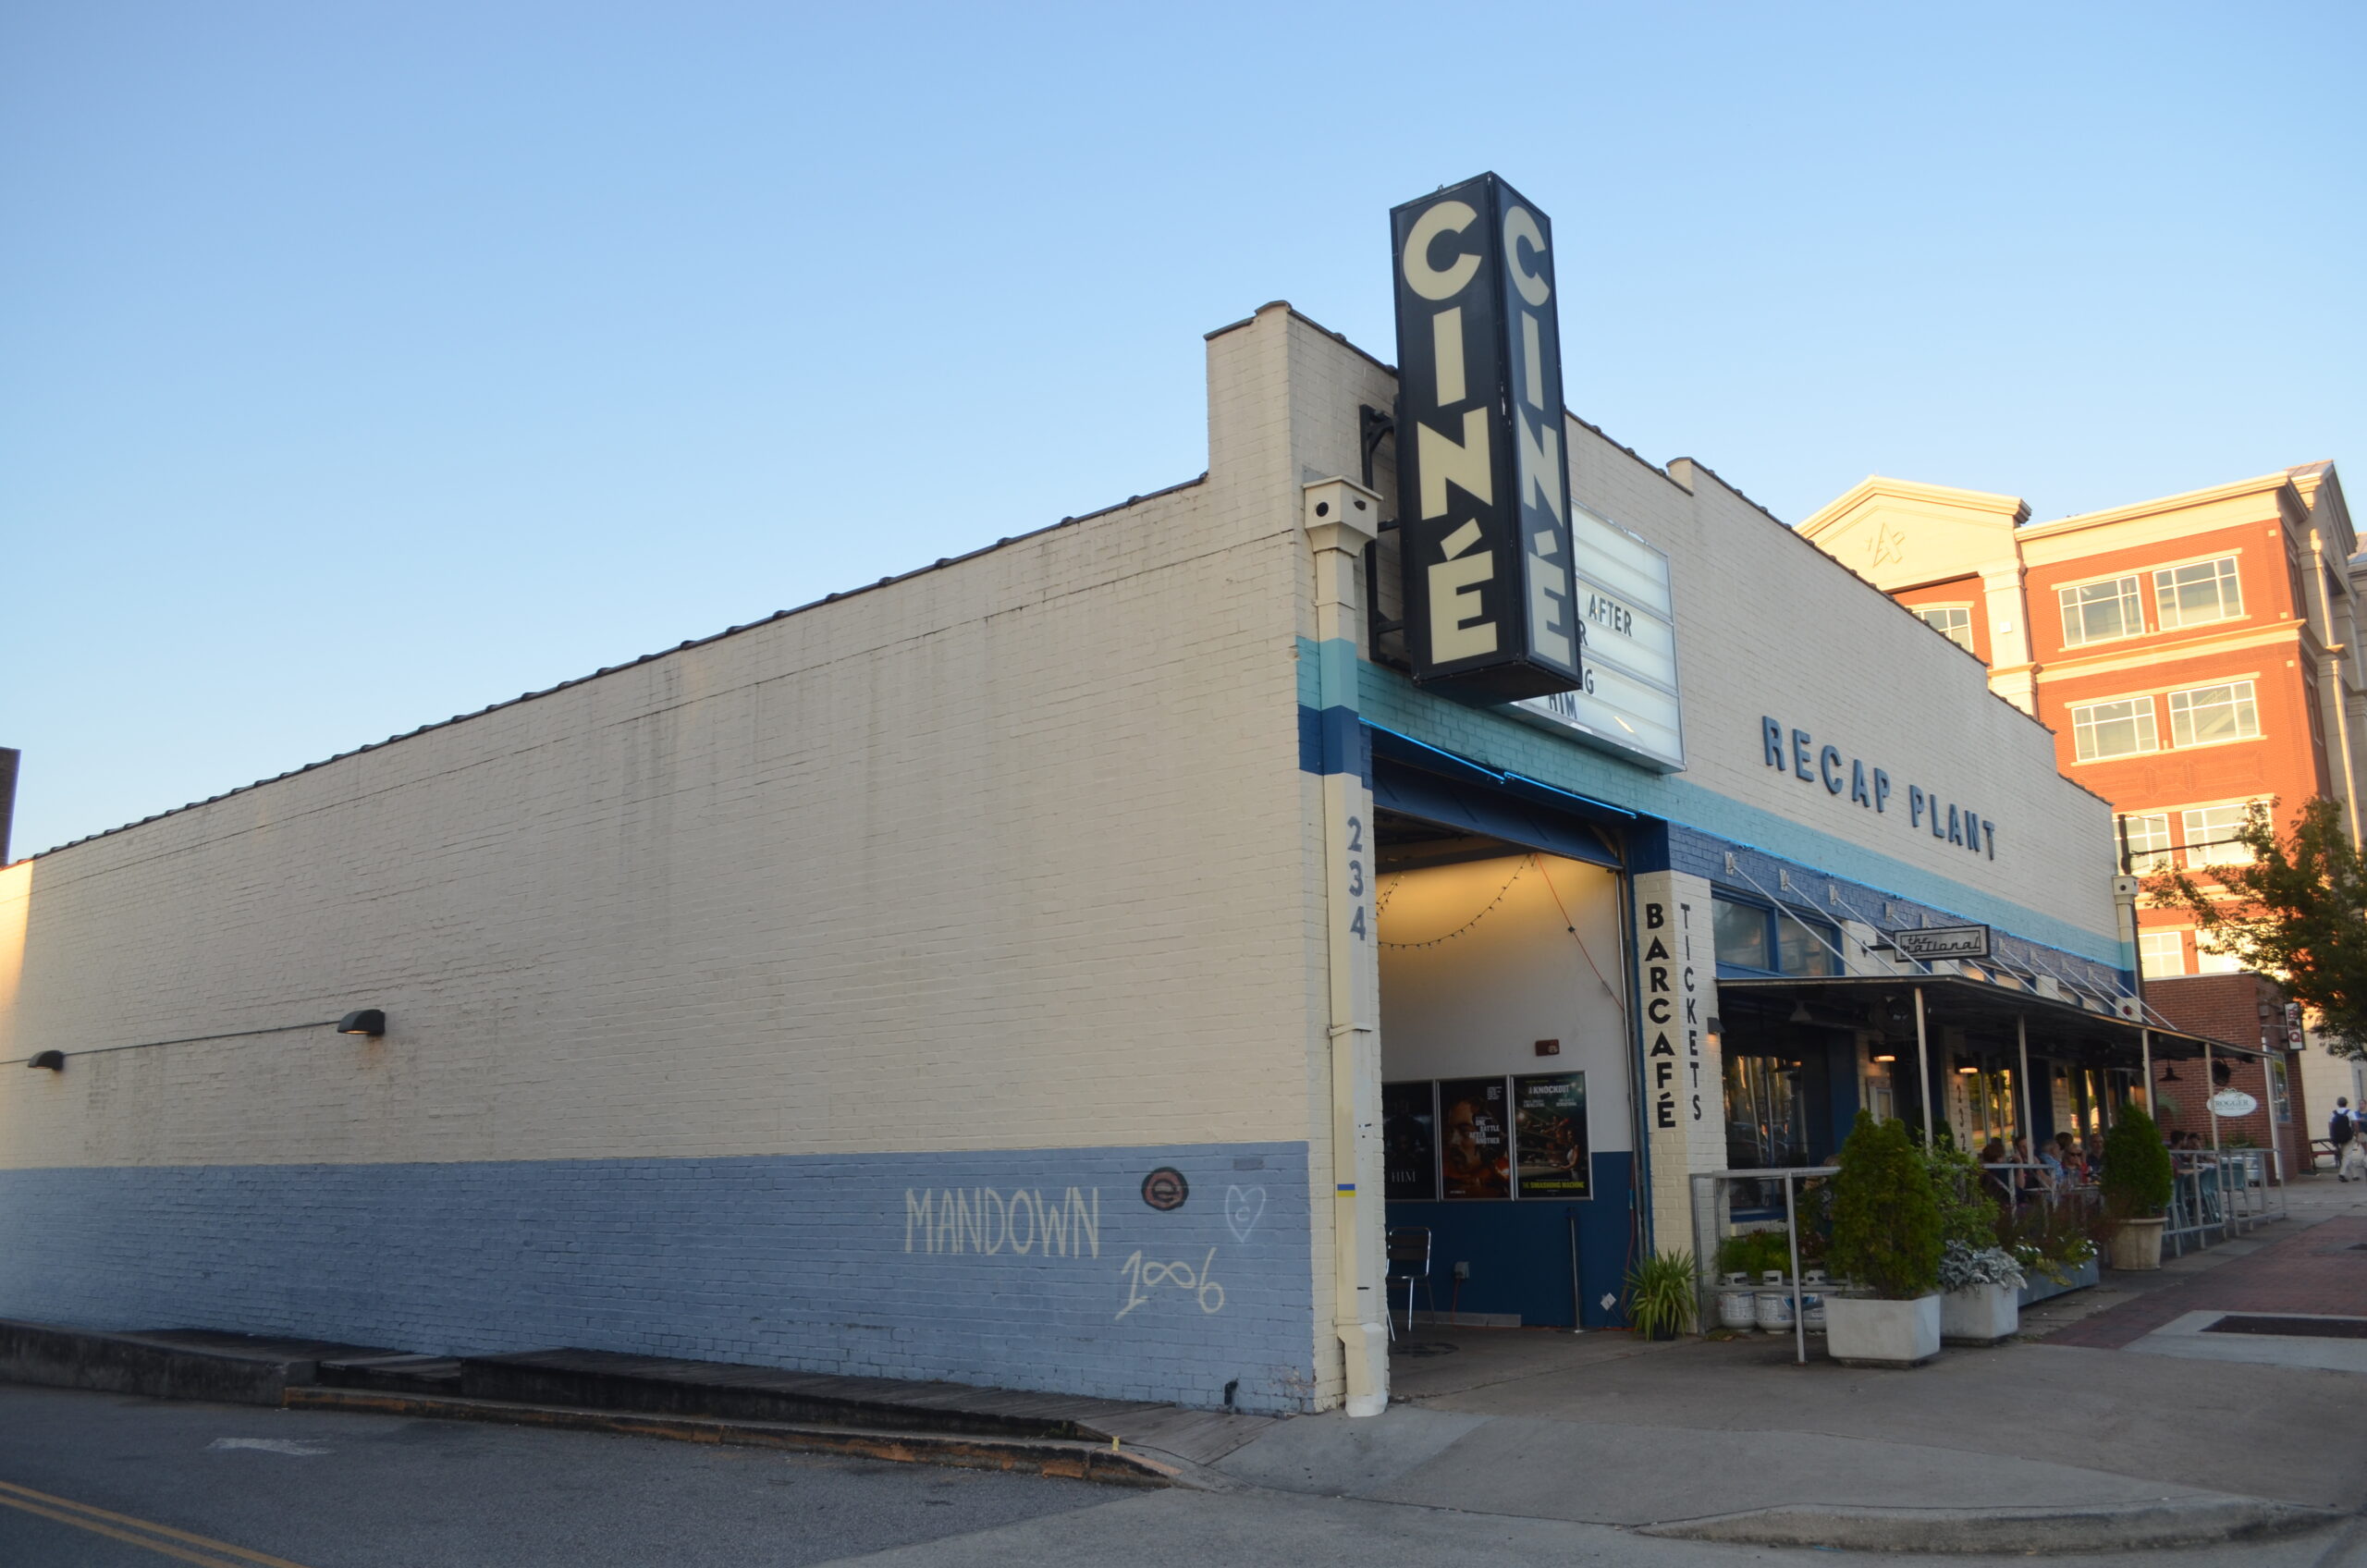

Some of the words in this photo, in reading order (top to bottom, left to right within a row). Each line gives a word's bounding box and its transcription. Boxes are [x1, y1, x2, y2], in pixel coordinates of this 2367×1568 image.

[1403, 200, 1499, 665] CINÉ
[1502, 205, 1572, 668] CINÉ
[1588, 594, 1632, 637] AFTER
[1549, 692, 1577, 720] HIM
[1762, 716, 1891, 814] RECAP
[1908, 784, 1995, 861] PLANT
[1346, 815, 1367, 941] 234
[1901, 937, 1981, 953] national
[1680, 902, 1702, 1121] TICKETS
[904, 1187, 1098, 1259] MANDOWN
[1392, 1170, 1417, 1183] HIM
